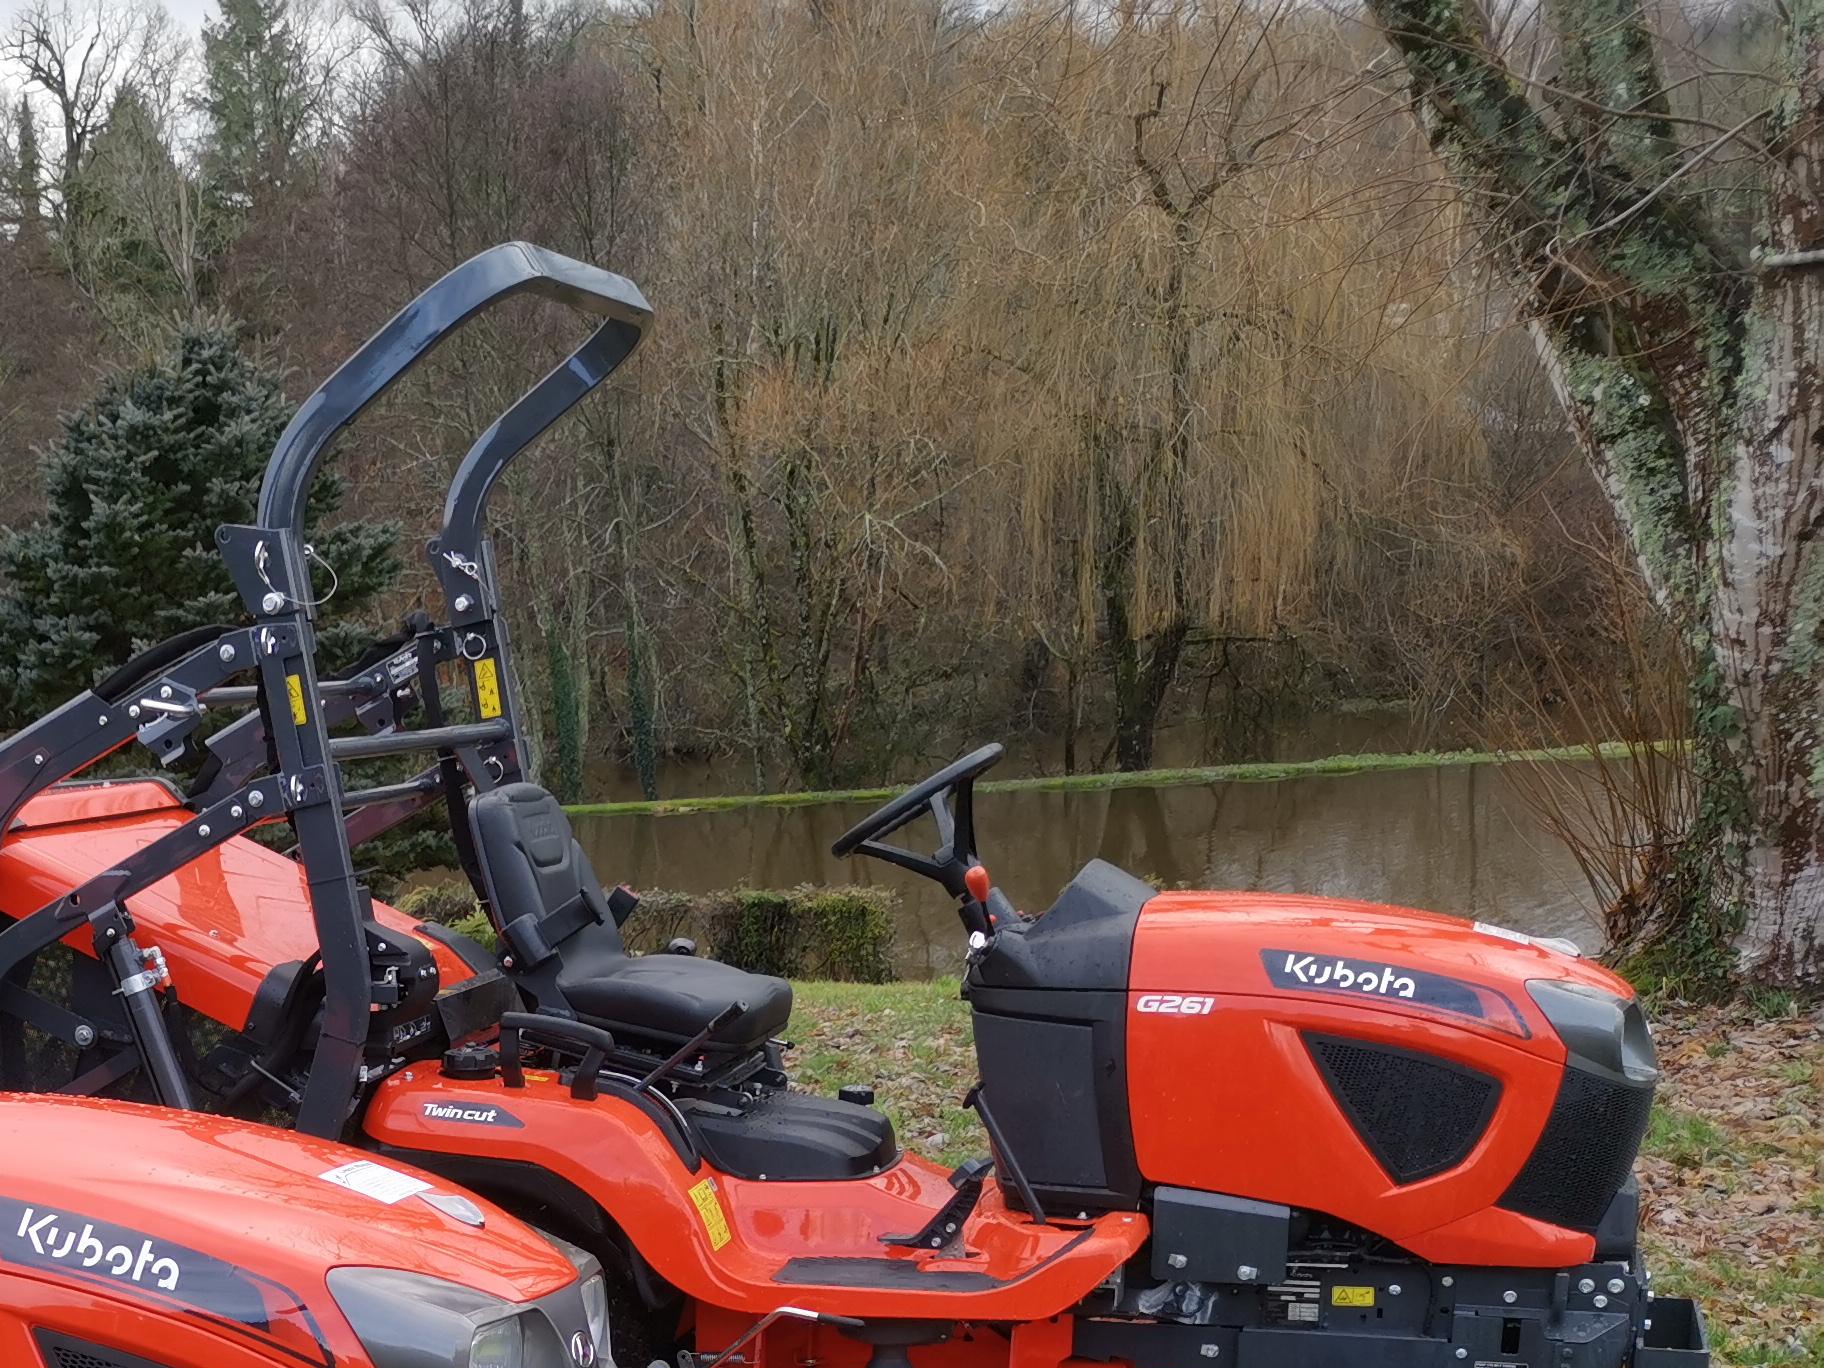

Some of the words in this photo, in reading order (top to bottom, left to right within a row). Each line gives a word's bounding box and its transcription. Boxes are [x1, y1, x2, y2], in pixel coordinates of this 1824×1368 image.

[1284, 954, 1416, 998] Kubota
[1136, 995, 1216, 1015] G261
[17, 1208, 180, 1291] Kubota
